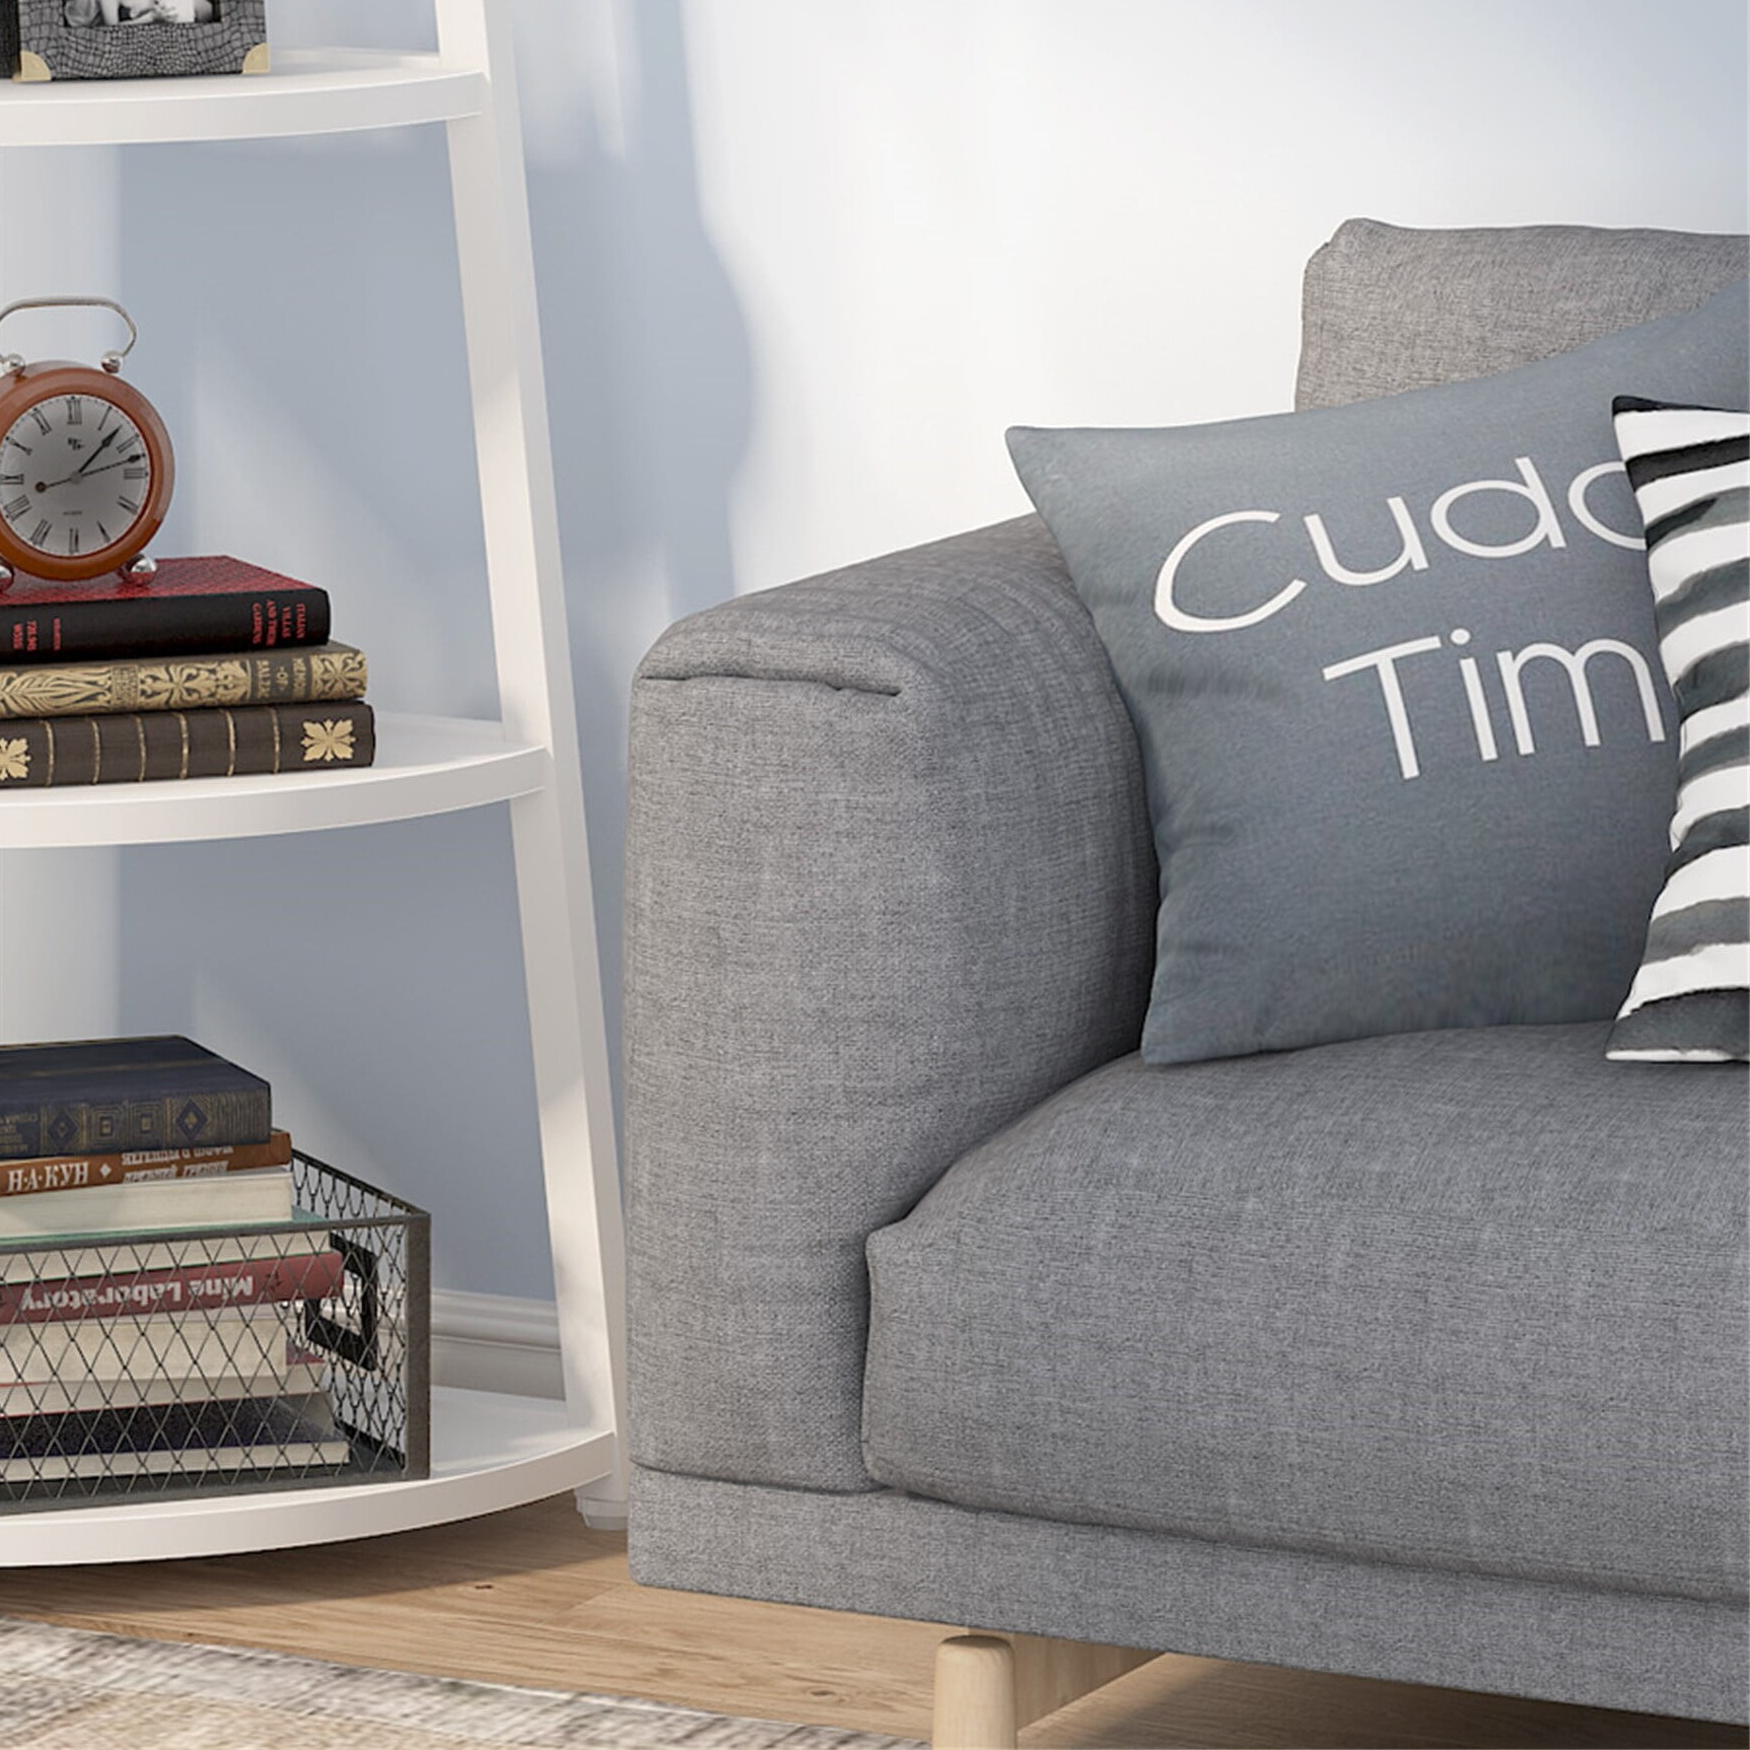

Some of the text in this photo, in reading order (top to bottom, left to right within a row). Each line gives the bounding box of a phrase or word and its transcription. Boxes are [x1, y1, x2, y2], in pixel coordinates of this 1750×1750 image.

[66, 400, 83, 425] XII
[123, 467, 146, 481] III
[21, 1276, 253, 1311] Mine Laboratory
